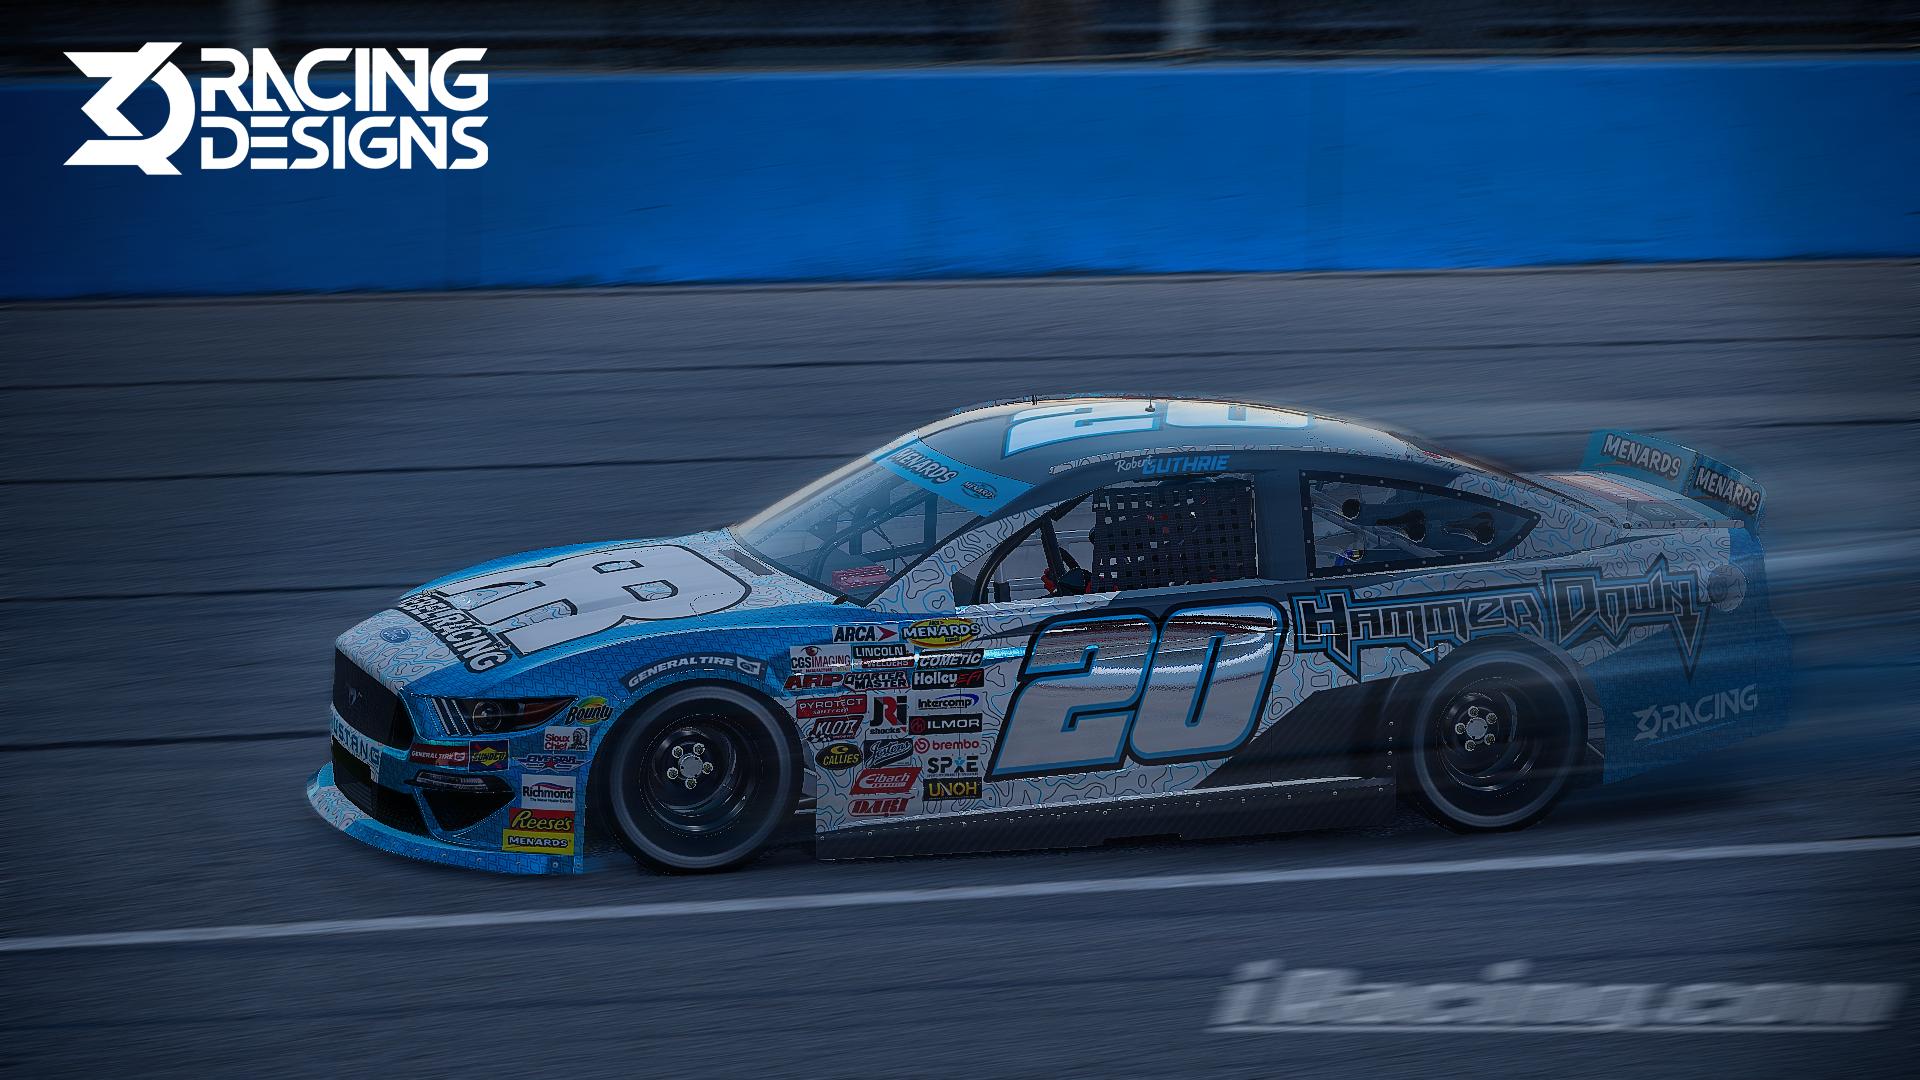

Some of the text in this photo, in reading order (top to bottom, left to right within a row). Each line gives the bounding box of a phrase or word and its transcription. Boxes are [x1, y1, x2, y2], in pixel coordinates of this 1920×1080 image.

[1142, 454, 1232, 475] GUTHRIE
[1602, 434, 1681, 479] MENARDS
[892, 448, 958, 483] MENARDS
[1695, 467, 1761, 513] MENARDS
[834, 626, 876, 642] ARCA
[902, 623, 981, 639] MENARDS
[422, 611, 508, 672] RACING
[856, 646, 903, 657] LINCOLN
[919, 652, 982, 667] COMETIC
[628, 656, 698, 688] GENERAL
[699, 656, 735, 667] TIRE
[844, 672, 904, 686] QUARTER
[914, 671, 958, 687] Holley
[784, 674, 843, 688] ARP
[854, 679, 907, 690] MASTER
[984, 597, 1288, 782] 20
[918, 698, 973, 709] Intercomp
[1662, 683, 1759, 732] RACING
[564, 704, 615, 727] Bounty
[815, 719, 857, 736] KLOTZ
[928, 719, 980, 729] ILMOR
[545, 733, 570, 743] Sioux
[932, 740, 980, 751] brembo
[412, 750, 438, 759] GENERAL
[545, 742, 568, 751] Chief
[823, 753, 860, 766] CALLIES
[859, 773, 911, 789] Eibach
[928, 781, 977, 797] UNOH
[522, 785, 574, 799] Richmond
[511, 809, 574, 832] Reese's
[508, 836, 569, 848] MENARDS
